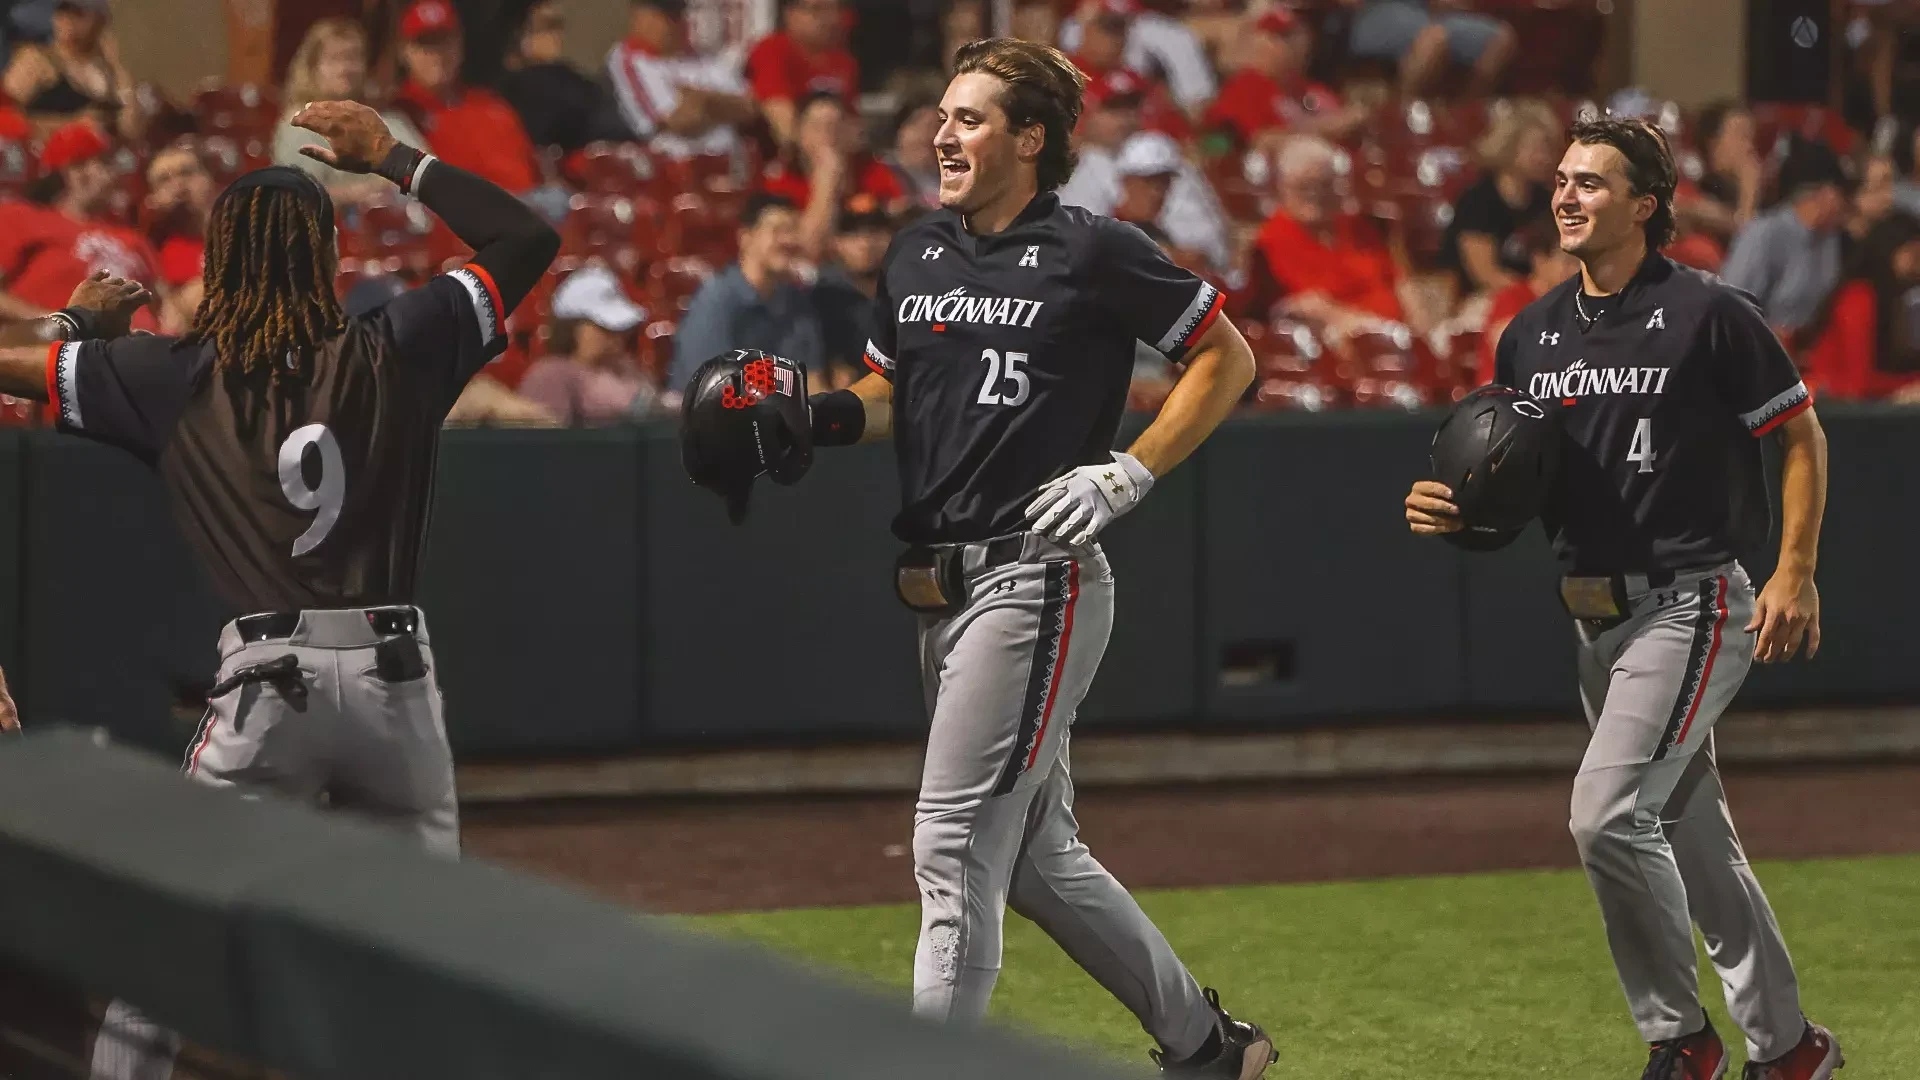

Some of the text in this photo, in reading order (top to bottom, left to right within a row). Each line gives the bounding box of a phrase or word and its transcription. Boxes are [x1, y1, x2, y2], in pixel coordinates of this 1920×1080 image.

[898, 286, 1044, 328] CINCINNATI
[976, 348, 1030, 407] 25
[1528, 358, 1670, 400] CINCINNATI
[1626, 417, 1658, 474] 4
[277, 423, 346, 558] 9
